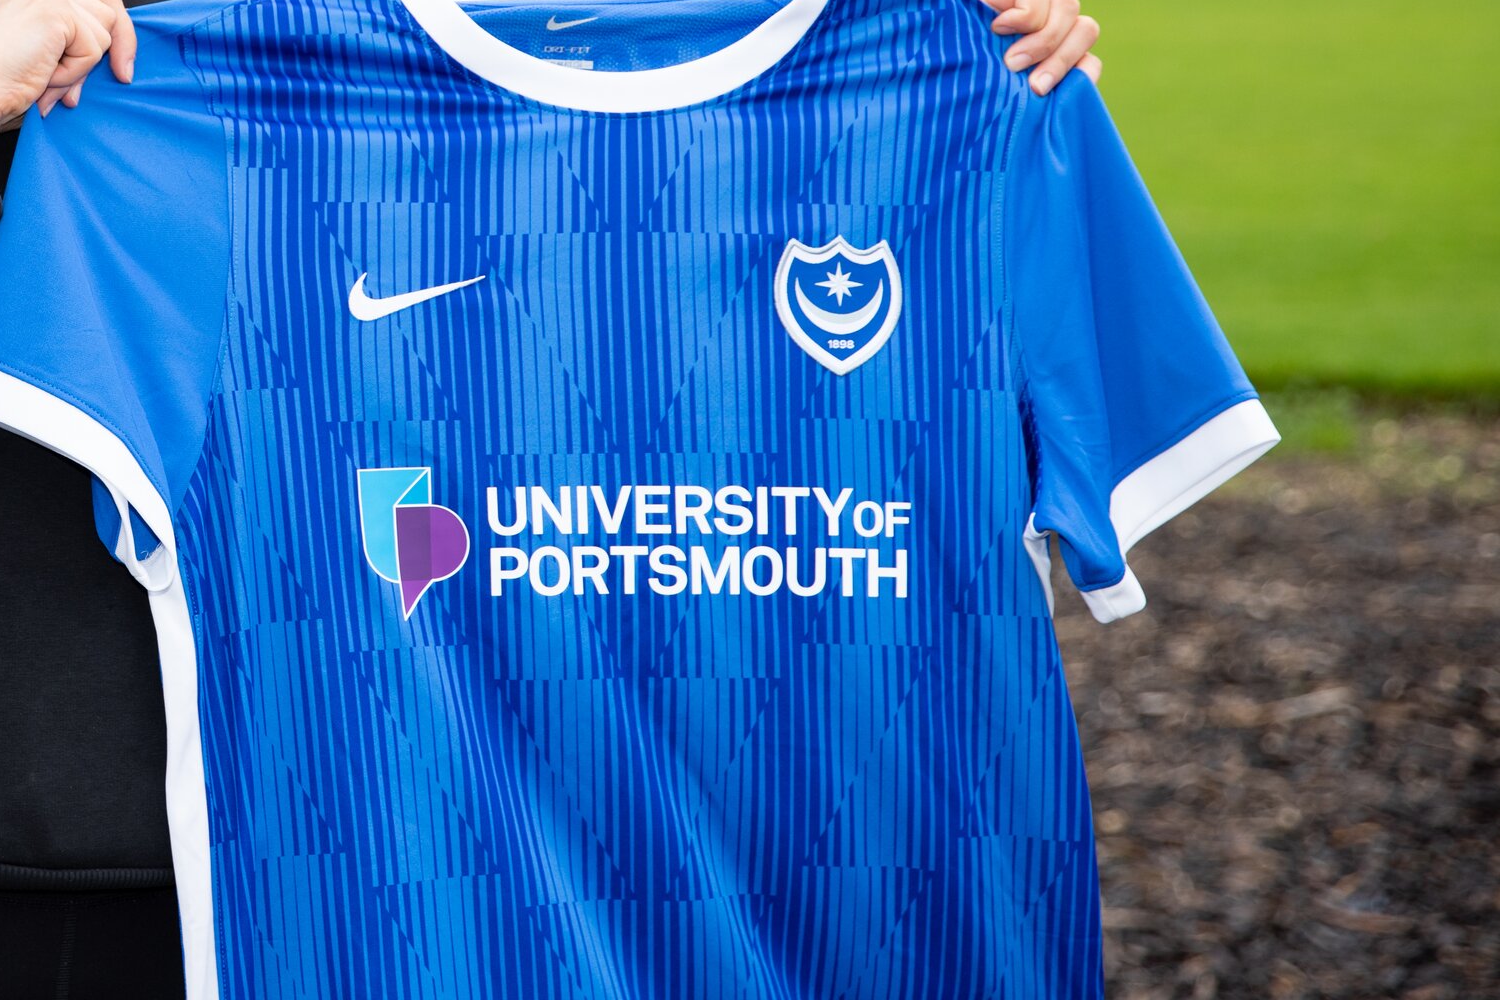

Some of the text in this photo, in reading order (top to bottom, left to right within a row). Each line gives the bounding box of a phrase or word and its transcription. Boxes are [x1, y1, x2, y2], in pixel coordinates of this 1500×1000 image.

[828, 340, 855, 349] 1898
[486, 485, 912, 538] UNIVERSITY OF
[491, 545, 908, 598] PORTSMOUTH
